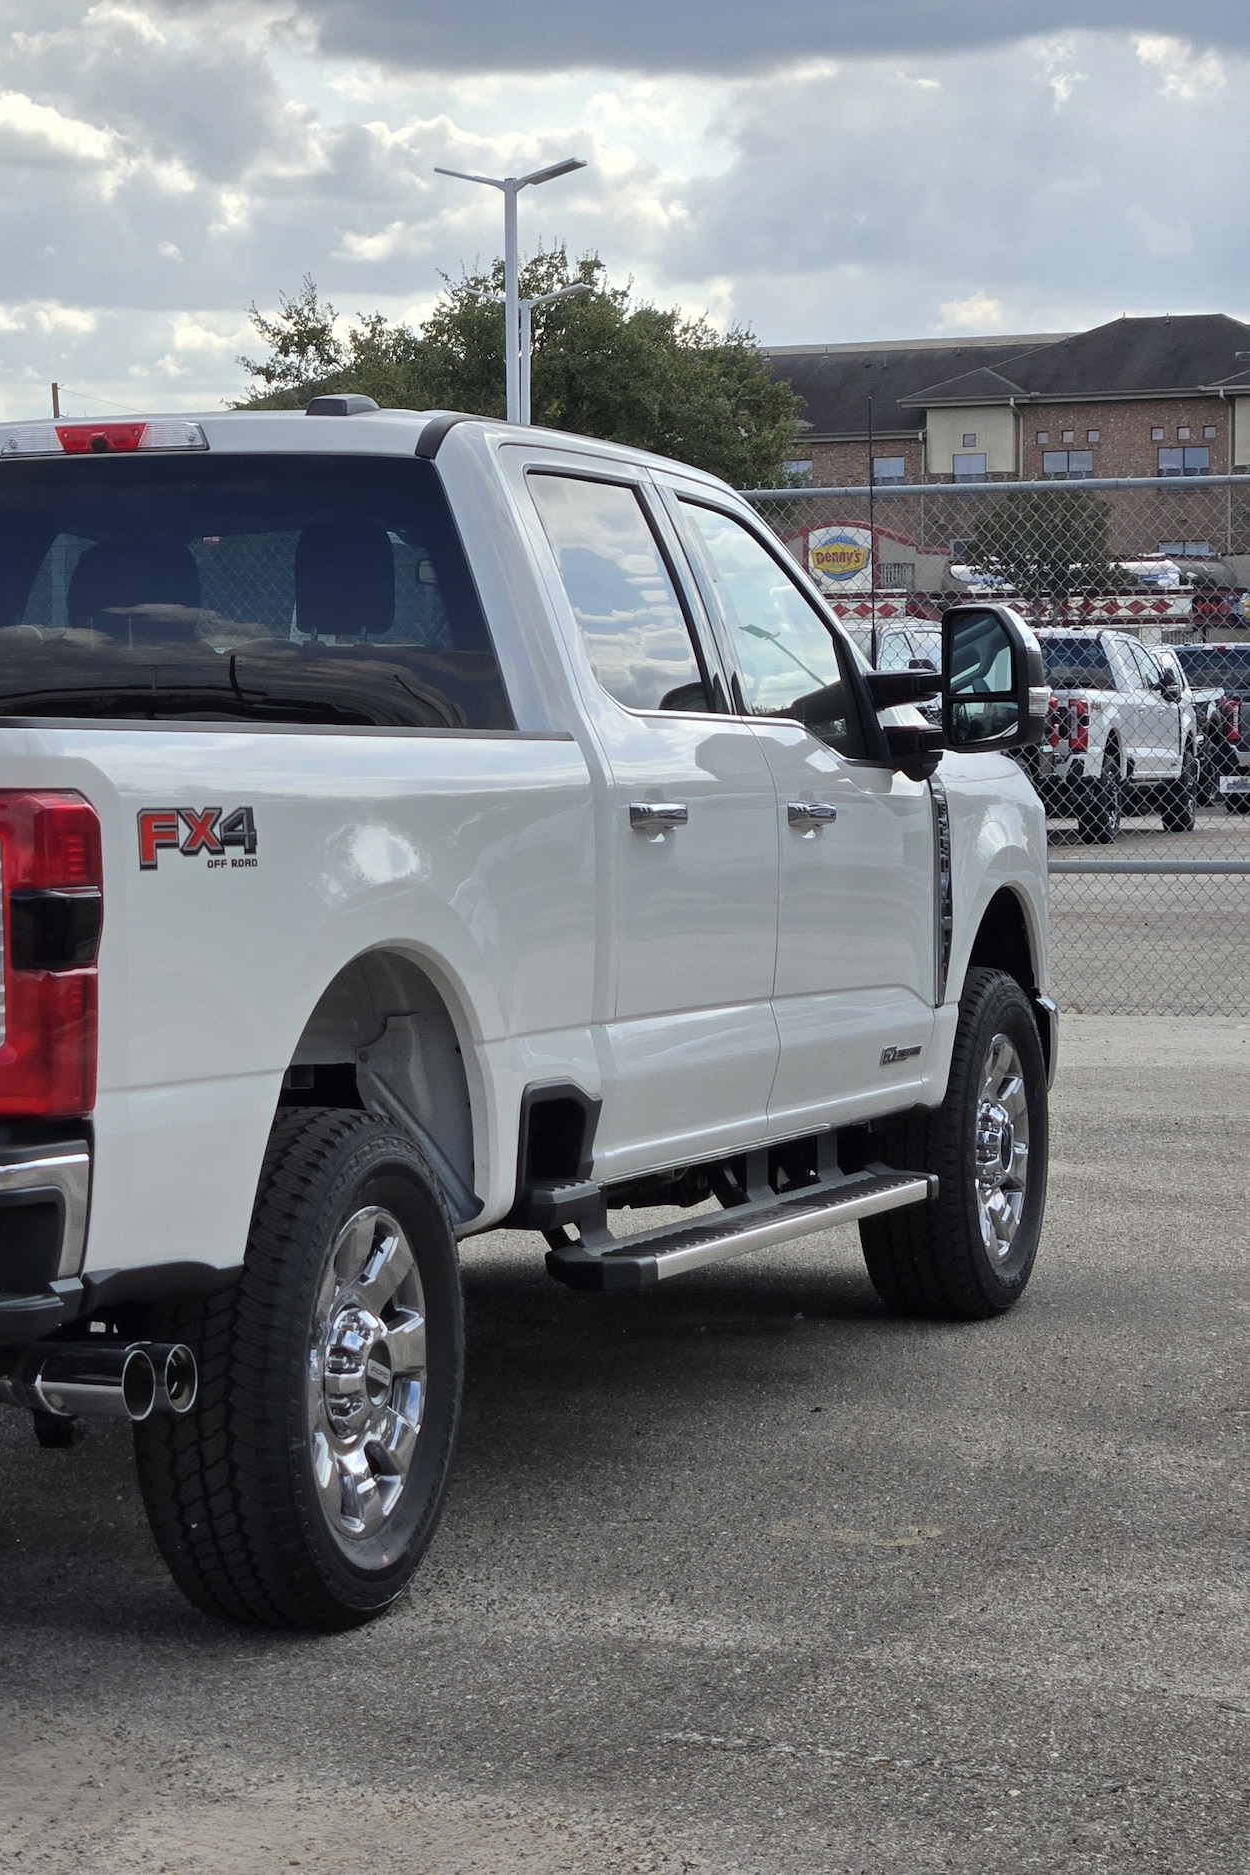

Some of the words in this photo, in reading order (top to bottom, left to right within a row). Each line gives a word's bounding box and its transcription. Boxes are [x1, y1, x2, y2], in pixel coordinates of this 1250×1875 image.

[815, 550, 862, 565] Denny's
[136, 806, 258, 871] FX4
[207, 859, 228, 869] OFF
[231, 858, 258, 868] ROAD
